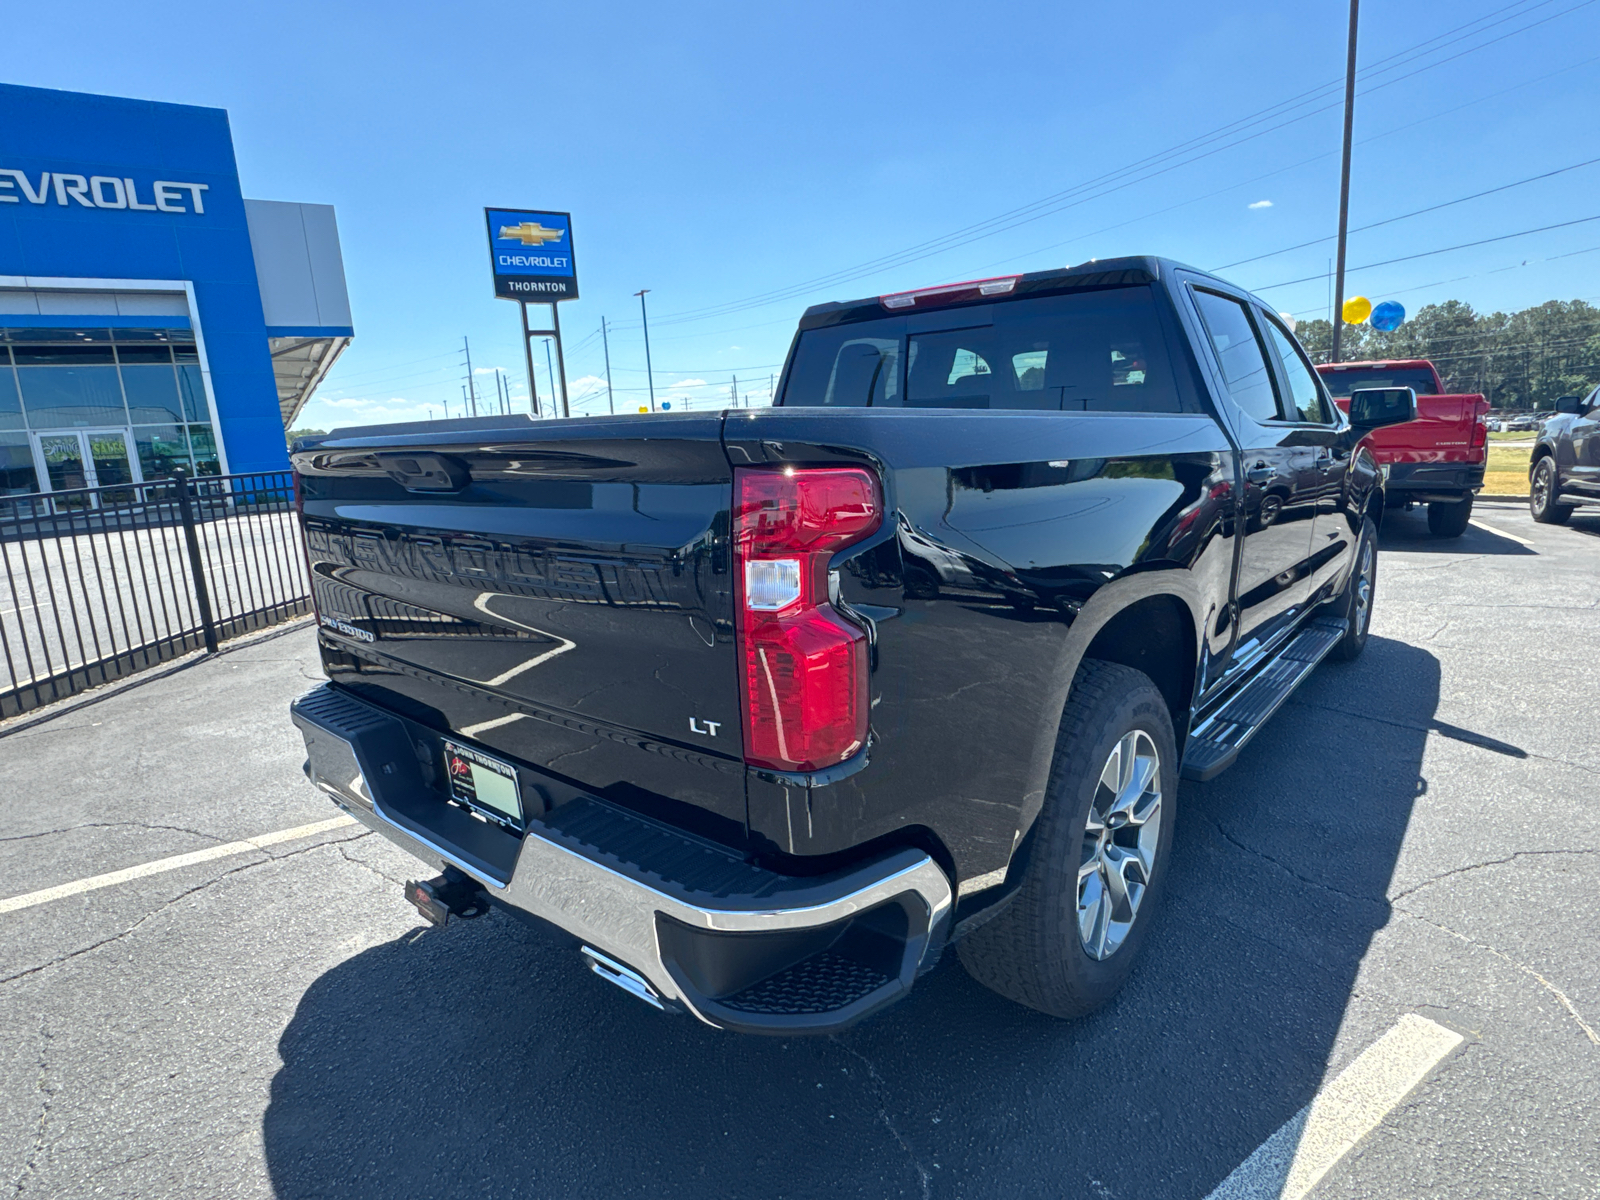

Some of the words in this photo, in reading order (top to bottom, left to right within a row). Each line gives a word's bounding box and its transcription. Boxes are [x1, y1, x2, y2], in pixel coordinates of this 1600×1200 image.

[499, 255, 568, 267] CHEVROLET
[508, 281, 566, 292] THORNTON
[689, 716, 721, 736] LT
[456, 747, 474, 760] JOHN
[474, 754, 511, 777] THORNTON
